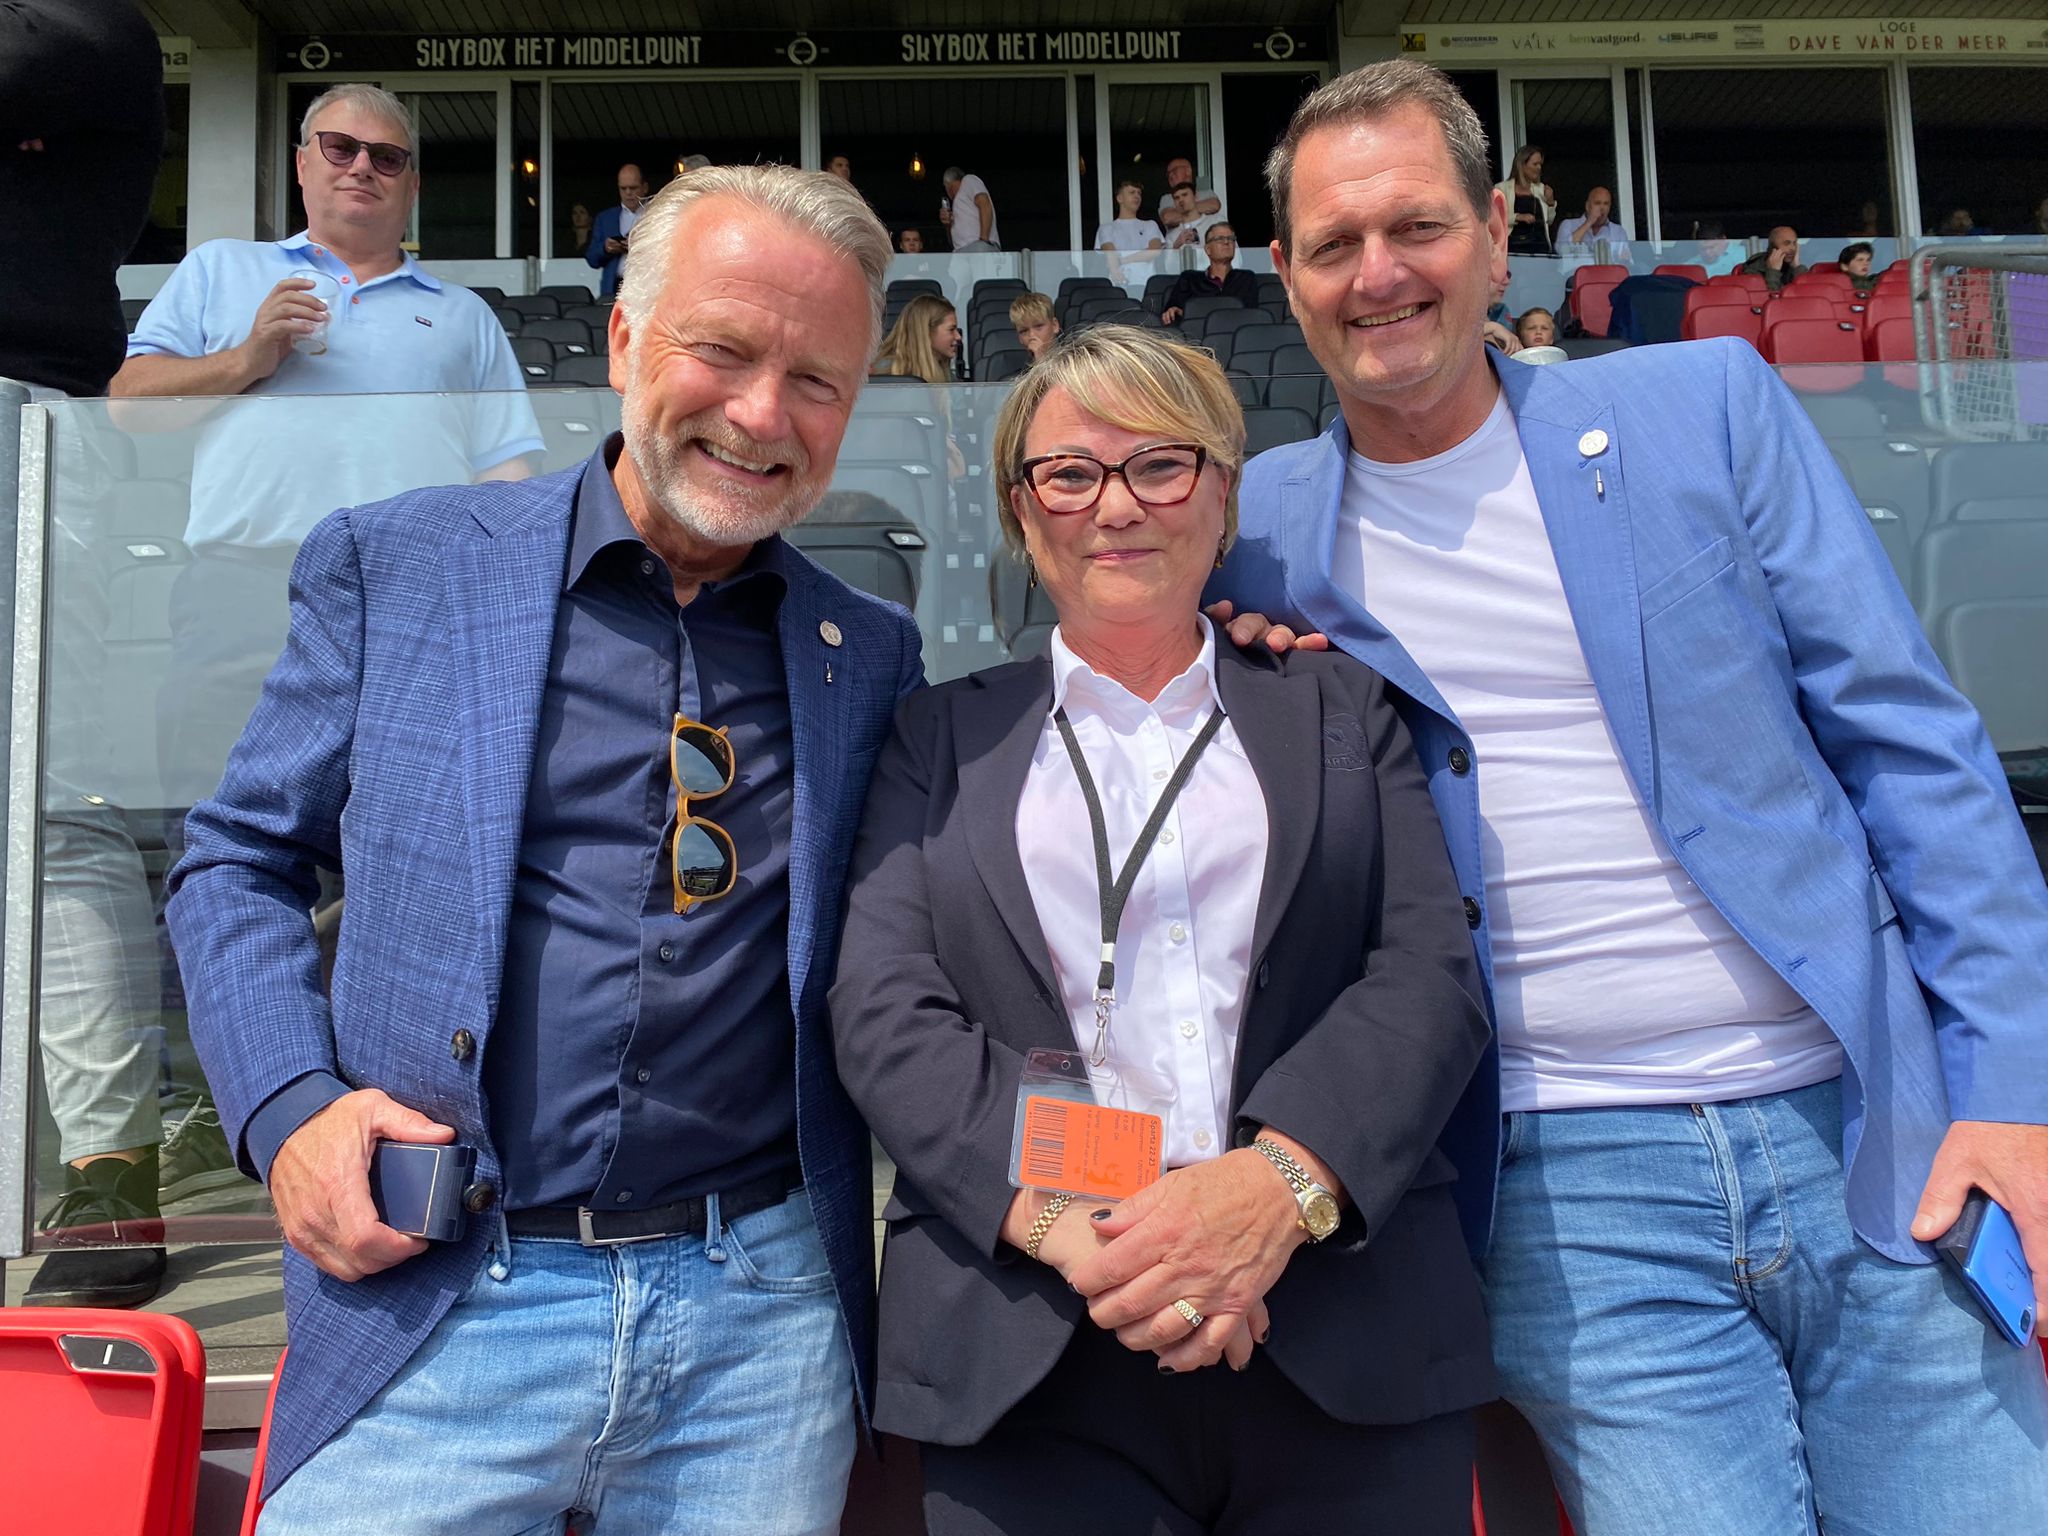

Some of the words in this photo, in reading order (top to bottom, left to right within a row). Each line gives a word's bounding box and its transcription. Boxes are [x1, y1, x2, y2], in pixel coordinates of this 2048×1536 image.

[1879, 21, 1917, 33] LOGE
[901, 33, 990, 62] SKYBOX
[998, 32, 1037, 61] HET
[1045, 31, 1181, 60] MIDDELPUNT
[1512, 38, 1556, 50] VALK
[1789, 35, 1841, 51] DAVE
[1856, 35, 1895, 50] VAN
[1906, 35, 1944, 50] DER
[1958, 35, 2007, 50] MEER
[416, 38, 506, 67] SKYBOX
[514, 37, 555, 65] HET
[564, 36, 702, 65] MIDDELPUNT
[901, 535, 910, 544] 9
